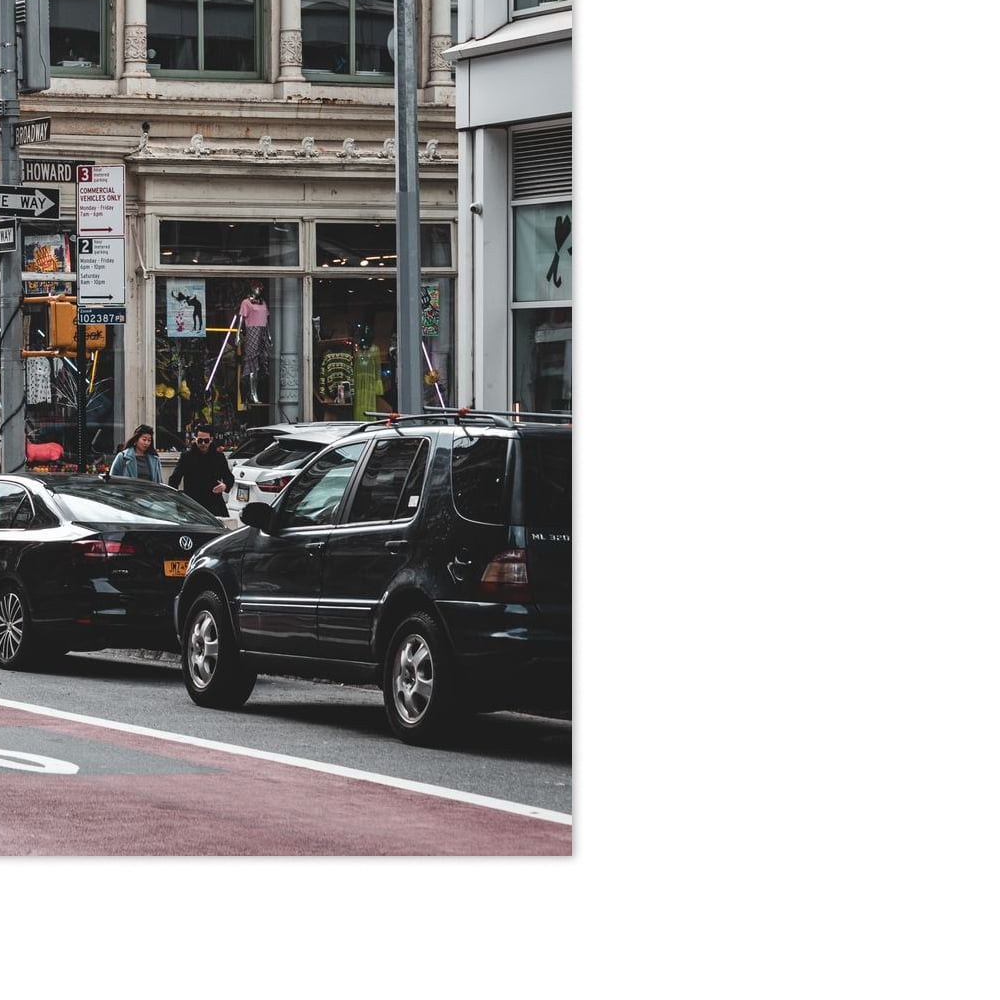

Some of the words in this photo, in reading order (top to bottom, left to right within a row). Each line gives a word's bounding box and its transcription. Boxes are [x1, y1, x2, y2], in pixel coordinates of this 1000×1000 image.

[15, 122, 49, 145] BROADWAY
[26, 162, 72, 181] HOWARD
[81, 167, 90, 181] 3
[20, 196, 47, 210] WAY
[0, 228, 12, 242] WAY
[81, 240, 90, 253] 2
